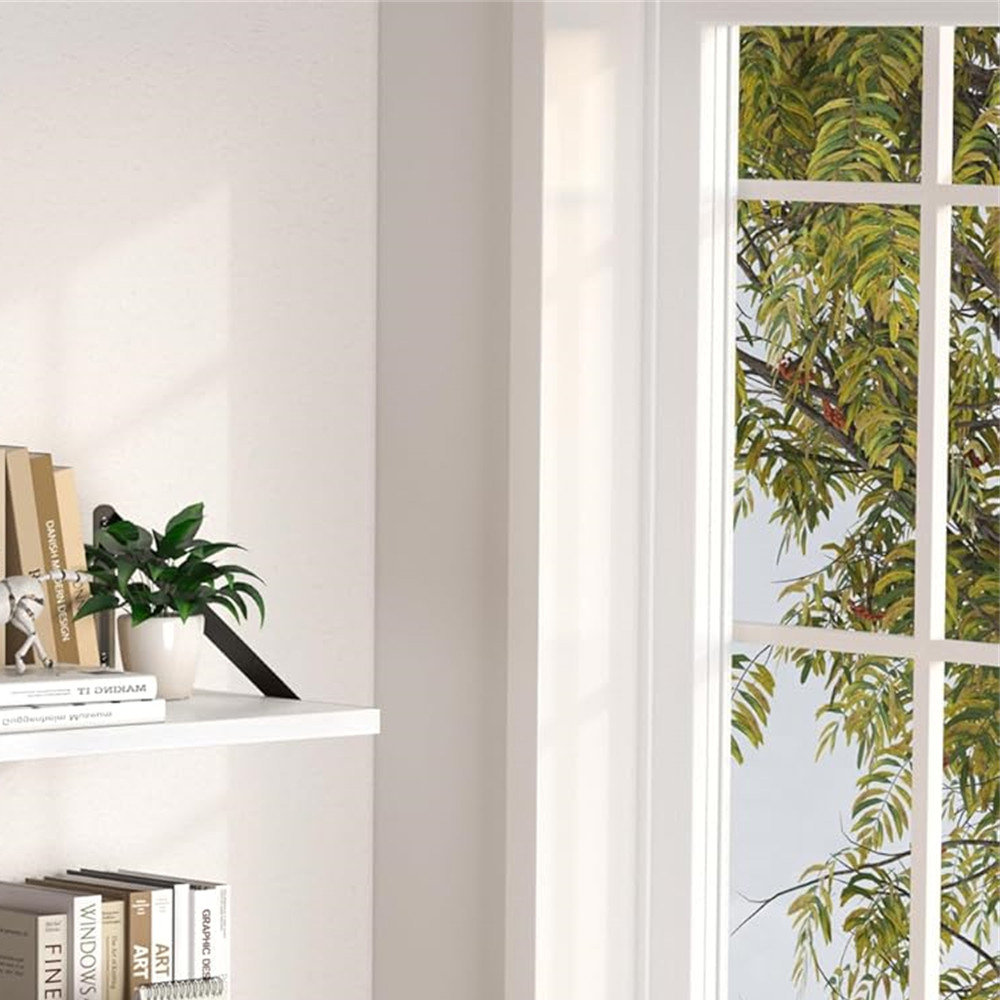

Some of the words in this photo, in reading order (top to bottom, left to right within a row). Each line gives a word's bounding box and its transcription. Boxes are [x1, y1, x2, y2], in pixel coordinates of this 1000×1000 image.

[45, 519, 60, 560] DANISH
[57, 605, 71, 642] DESIGN
[80, 903, 97, 995] WINDOWS
[201, 909, 211, 955] GRAPHIC
[45, 943, 62, 1000] FINE
[132, 944, 150, 980] ART
[155, 944, 170, 977] ART
